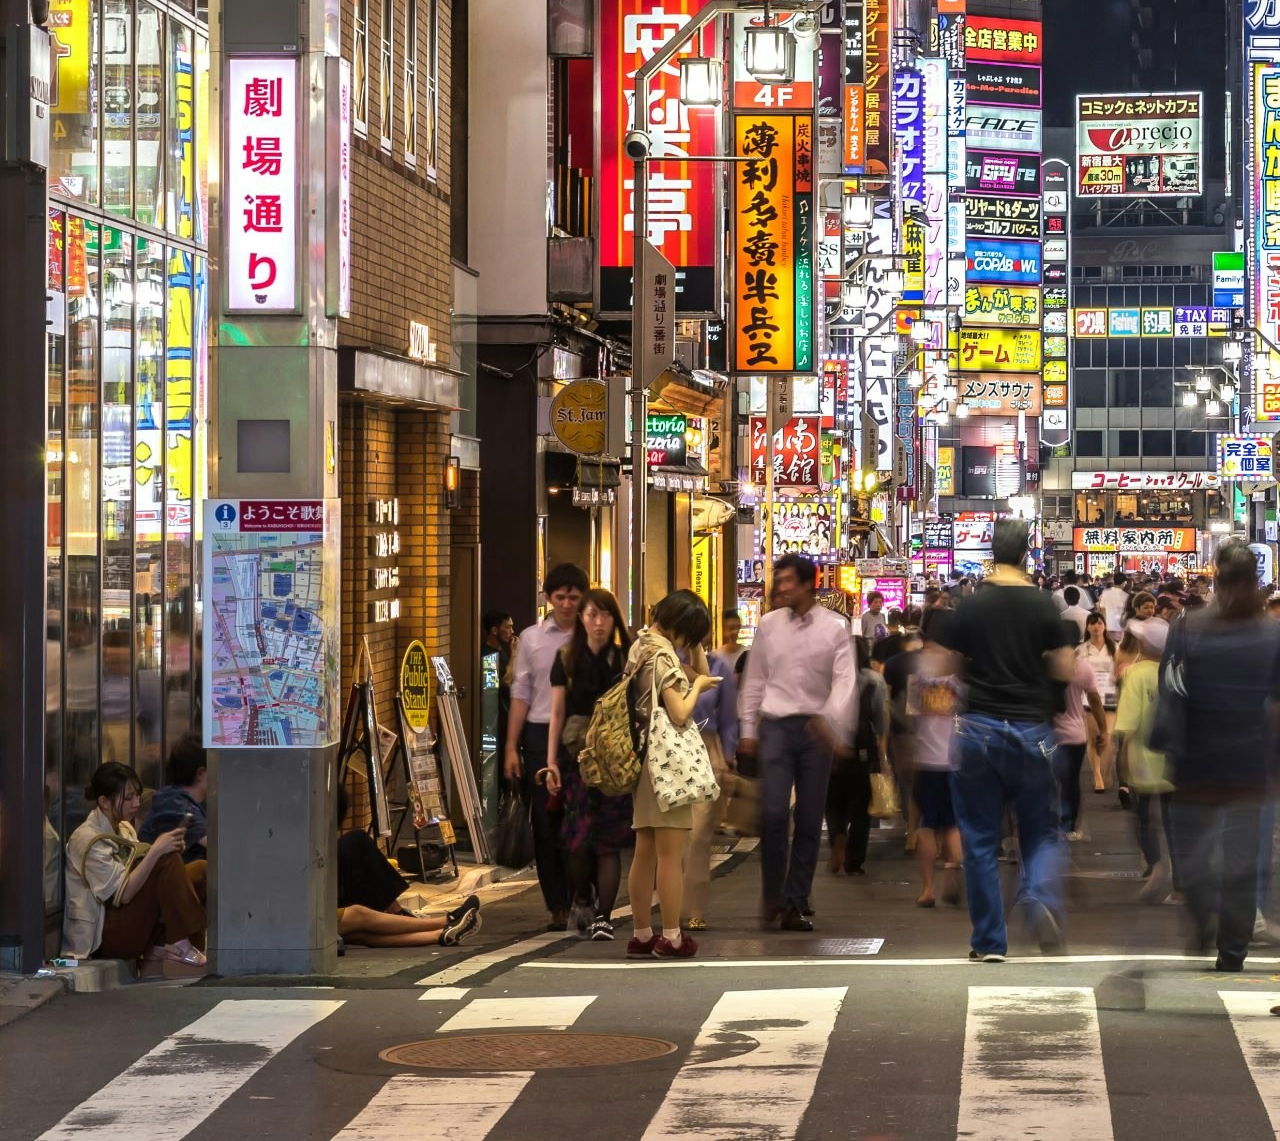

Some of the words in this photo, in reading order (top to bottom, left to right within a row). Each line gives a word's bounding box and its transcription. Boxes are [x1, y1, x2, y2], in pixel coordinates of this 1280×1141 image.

[965, 27, 1039, 53] 全店営業中
[754, 86, 794, 107] 4F
[954, 80, 965, 129] カラオケ
[1081, 99, 1198, 115] コミック&ネットカフェ
[966, 116, 1039, 133] FACE
[797, 123, 811, 183] 炭火串焼
[1137, 142, 1190, 150] アプレシオ
[1082, 156, 1123, 167] 新宿最大
[243, 77, 283, 290] 劇場通り
[1082, 184, 1122, 193] ハイジアB1
[906, 223, 921, 274] 麻雀
[964, 287, 1037, 313] まんが喫茶
[653, 273, 666, 356] 劇場通り一番街
[1110, 314, 1139, 333] Fishing
[1144, 313, 1172, 333] 釣具
[1185, 309, 1207, 322] TAX
[798, 294, 811, 355] 楽しいお店
[1180, 324, 1203, 335] 免税
[963, 342, 1010, 363] ゲーム
[965, 380, 1034, 398] メンズサウナ
[1226, 443, 1257, 457] 完全
[1241, 457, 1271, 472] 個室
[1091, 473, 1142, 488] コーヒー
[1178, 472, 1203, 488] クール
[957, 529, 992, 545] ゲーム
[1084, 529, 1174, 545] 無料案内所
[409, 650, 423, 665] THE
[404, 664, 428, 688] Public
[404, 690, 428, 711] Stand
